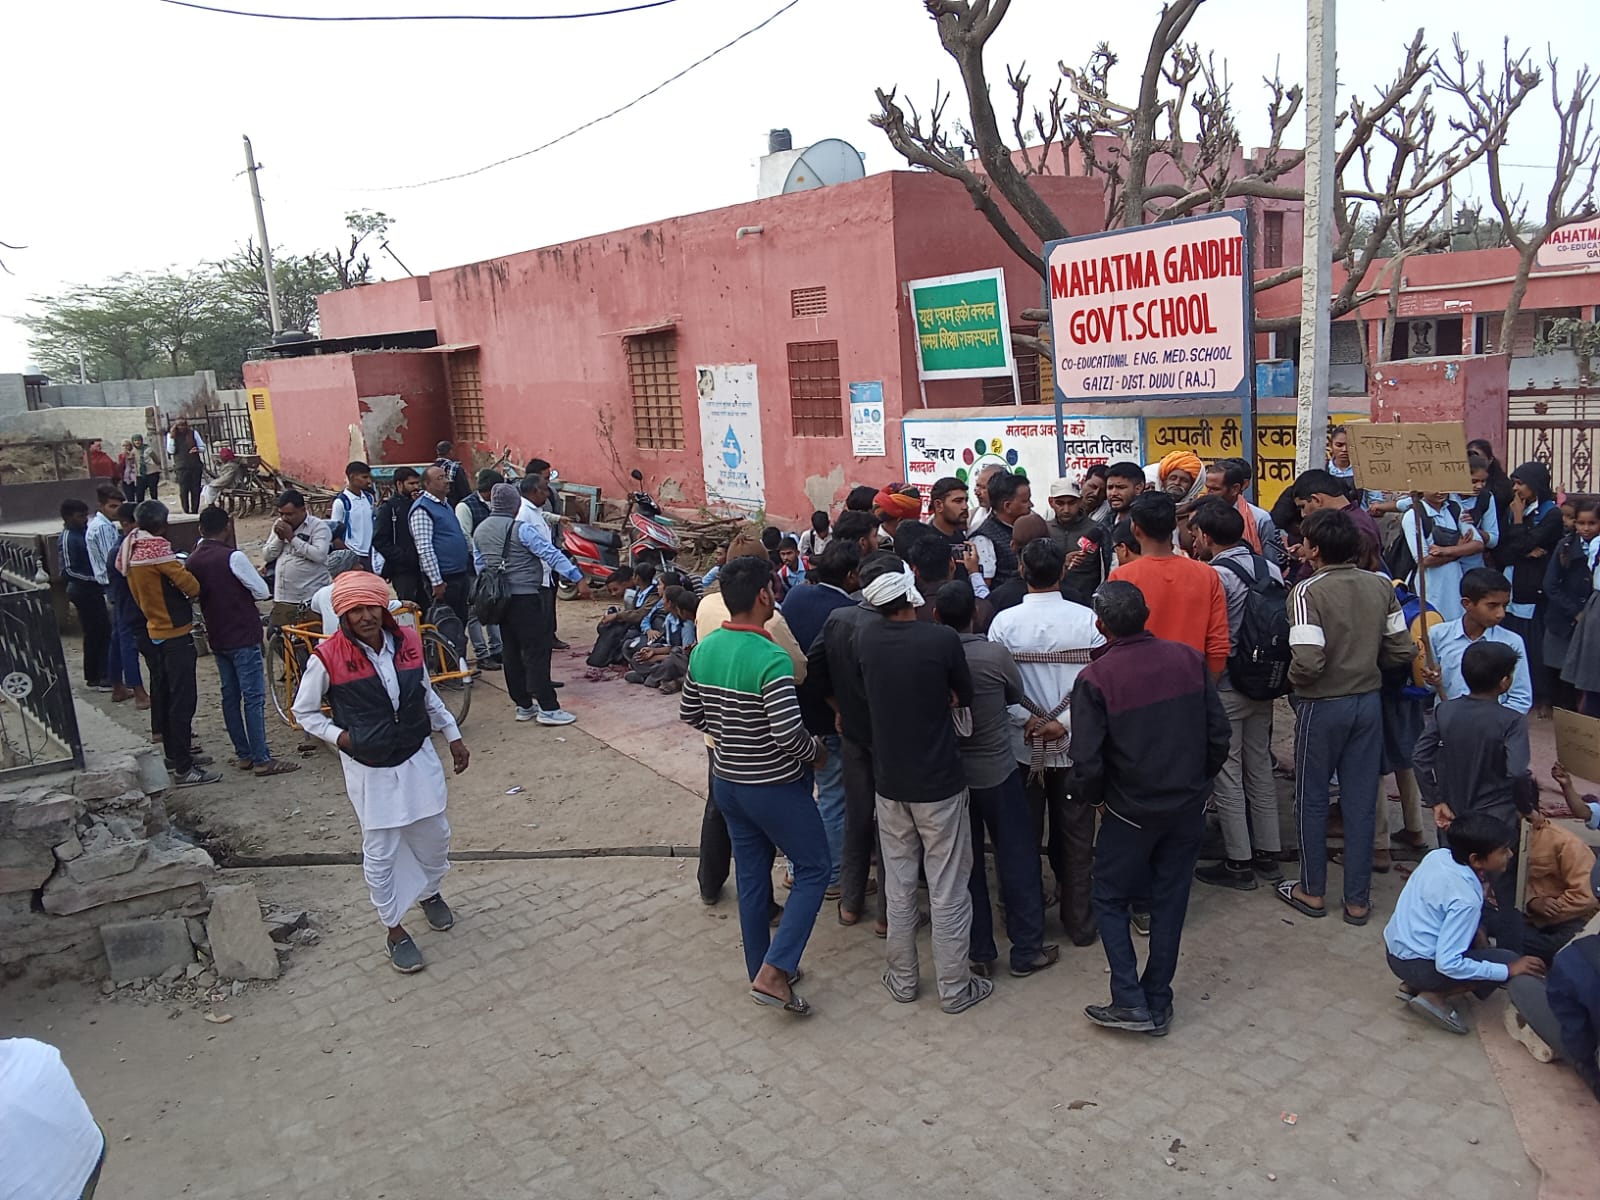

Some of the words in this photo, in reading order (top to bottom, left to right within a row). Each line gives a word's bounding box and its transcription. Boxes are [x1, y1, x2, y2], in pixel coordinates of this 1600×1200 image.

[1050, 250, 1160, 299] MAHATMA
[1164, 236, 1243, 284] GANDHI
[1061, 353, 1129, 371] CO-EDUCATIONAL
[1134, 352, 1159, 366] ENG.
[1149, 374, 1176, 389] DUDU
[1006, 424, 1038, 438] मतदान
[1155, 418, 1213, 447] अपनी
[1220, 418, 1238, 451] ही
[1064, 439, 1100, 456] तदान
[1101, 435, 1133, 457] दिवस
